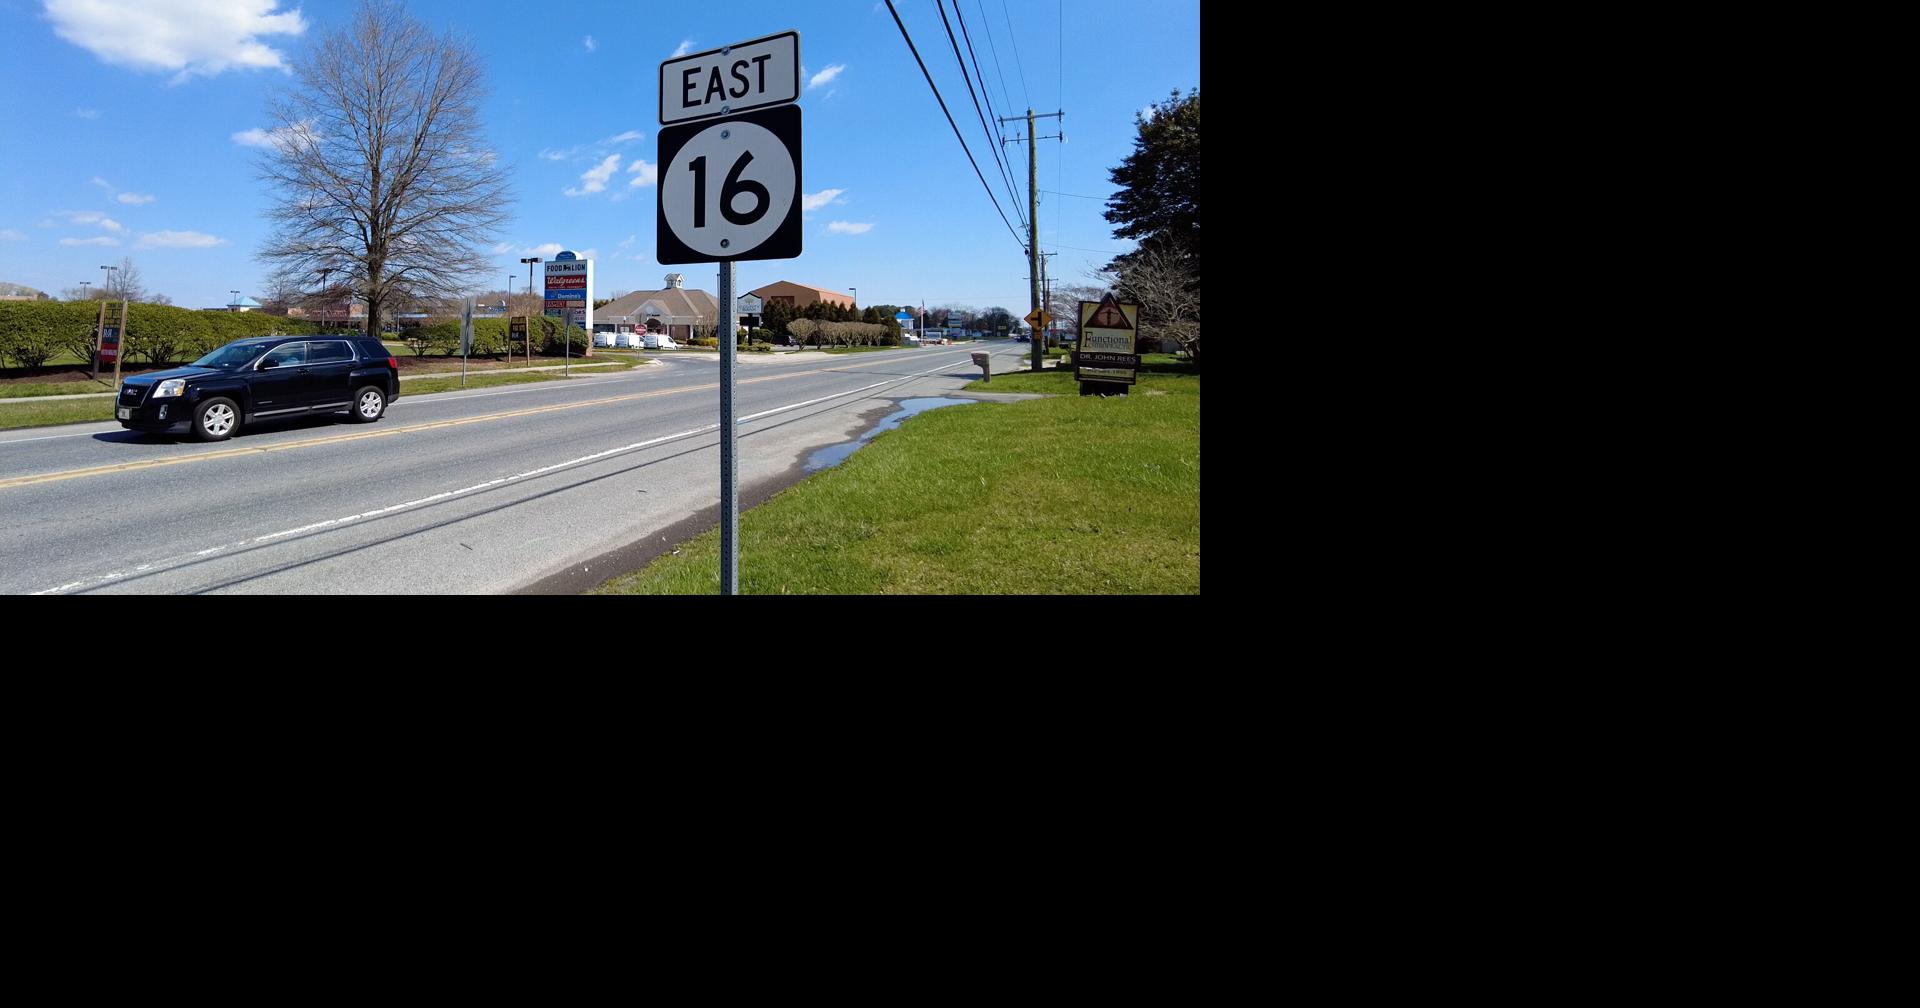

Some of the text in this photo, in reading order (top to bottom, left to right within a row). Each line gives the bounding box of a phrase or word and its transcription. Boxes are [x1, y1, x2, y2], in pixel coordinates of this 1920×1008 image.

[682, 54, 772, 109] EAST
[688, 149, 771, 229] 16
[547, 277, 585, 286] Walgreens
[1083, 331, 1132, 348] Functional
